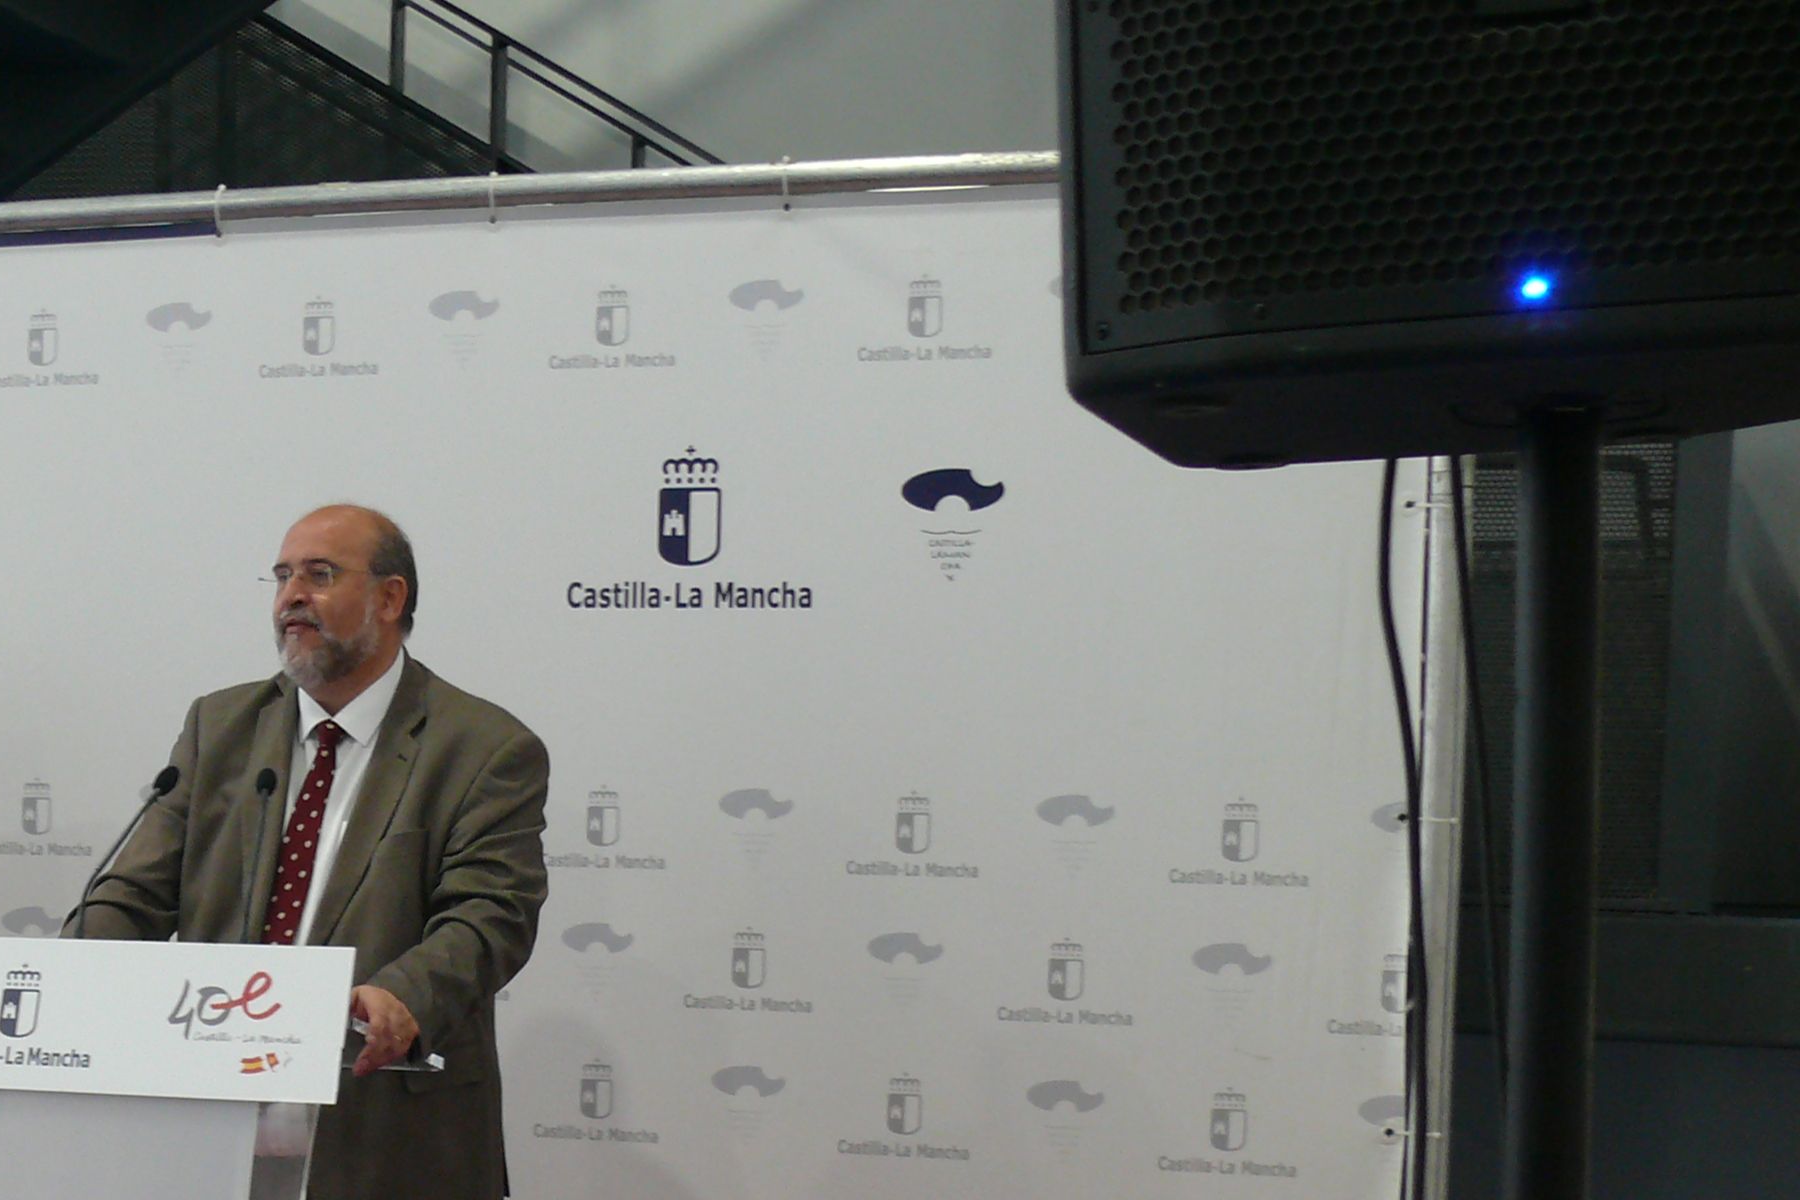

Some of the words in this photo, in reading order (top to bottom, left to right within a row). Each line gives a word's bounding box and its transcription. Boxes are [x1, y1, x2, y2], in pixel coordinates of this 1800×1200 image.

[942, 345, 993, 360] Mancha
[566, 581, 703, 610] Castilla-La
[714, 581, 813, 609] Mancha
[26, 1046, 92, 1068] Mancha
